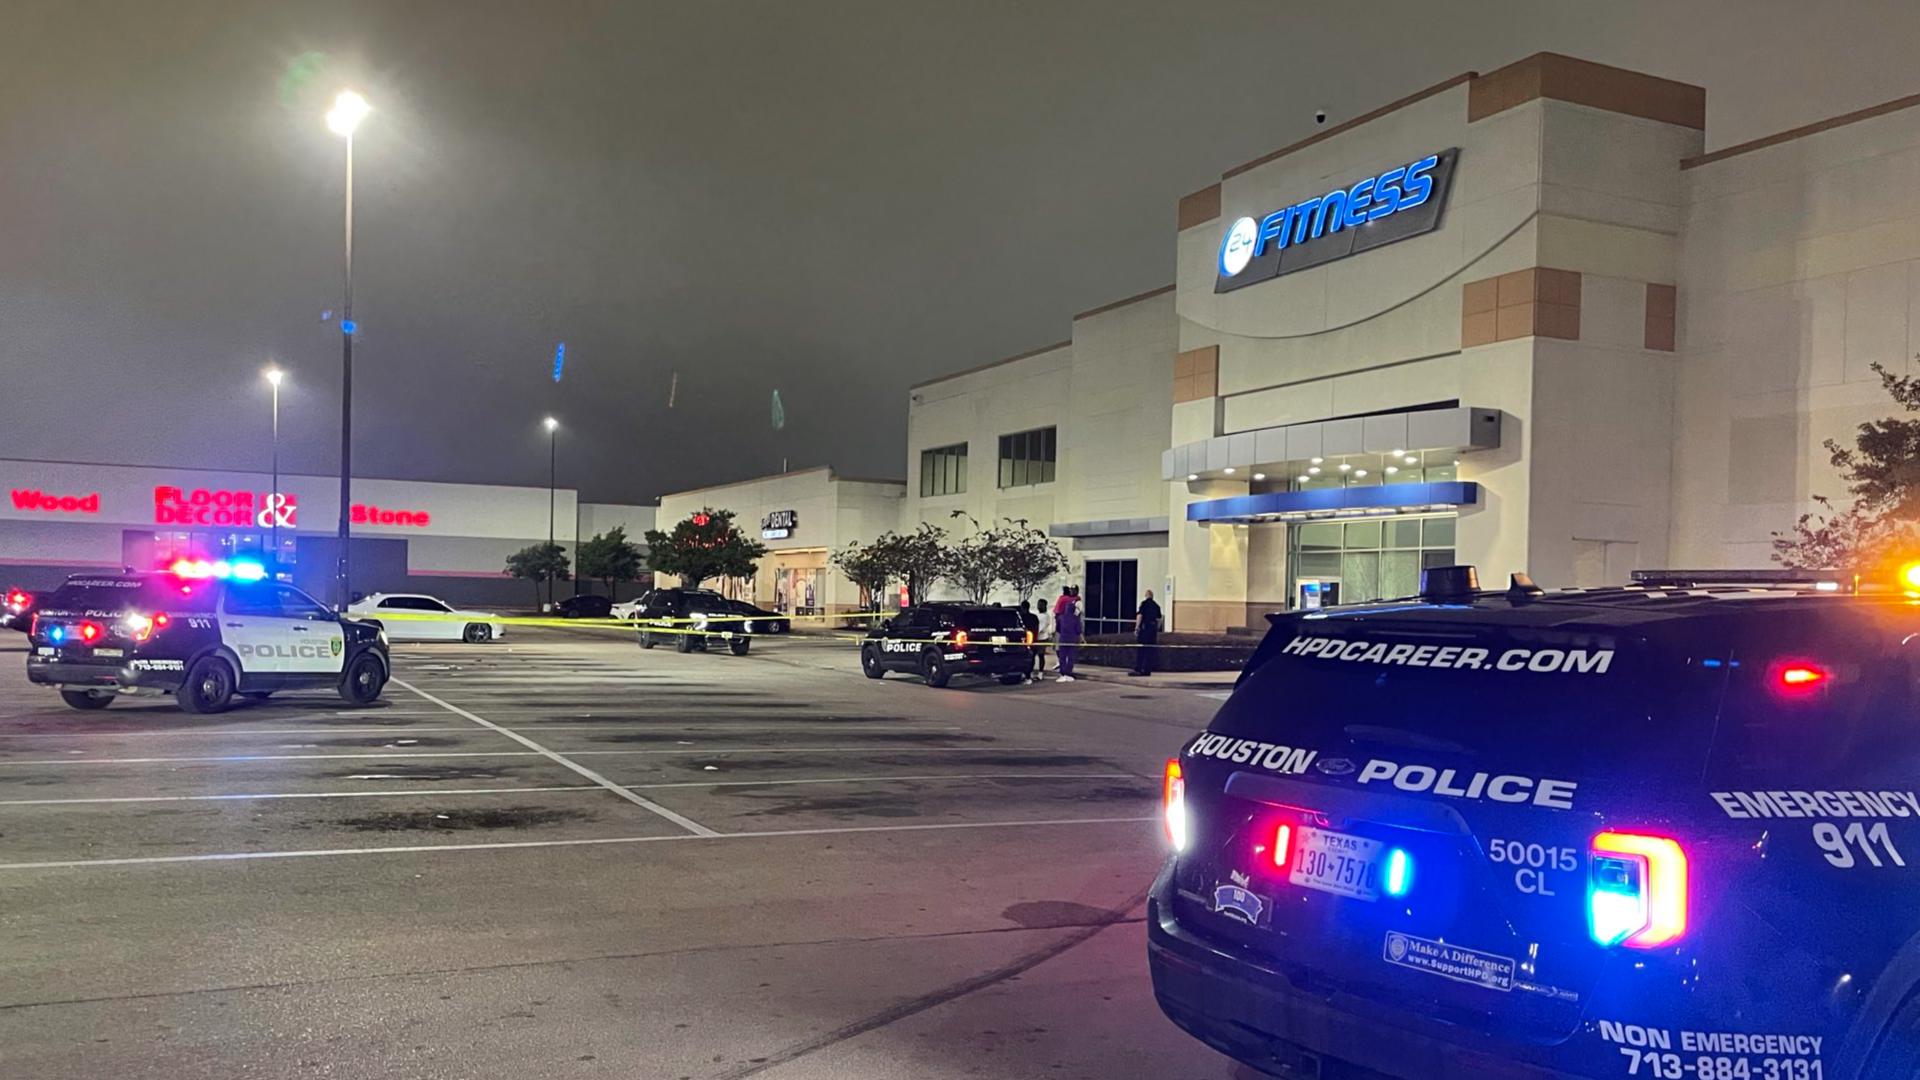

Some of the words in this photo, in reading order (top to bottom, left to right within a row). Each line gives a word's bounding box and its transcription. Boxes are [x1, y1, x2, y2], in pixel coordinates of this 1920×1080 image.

[1254, 154, 1438, 257] FITNESS
[11, 488, 100, 513] Wood
[154, 485, 254, 506] FLOOR
[155, 505, 254, 526] DECOR
[257, 493, 297, 528] &
[351, 503, 430, 528] Stone
[188, 618, 211, 629] 911
[237, 644, 330, 658] POLICE
[886, 642, 922, 653] POLICE
[1282, 637, 1614, 673] HPDCAREER.COM
[1189, 732, 1317, 774] HOUSTON
[1357, 759, 1577, 810] POLICE
[1709, 791, 1920, 818] EMERGENCY
[1323, 835, 1358, 851] TEXAS
[1490, 839, 1578, 872] 50015
[1812, 822, 1906, 868] 911
[1515, 868, 1555, 896] CL
[1408, 955, 1509, 987] www.SupportHPD.org
[1409, 941, 1439, 957] Make
[1440, 950, 1450, 960] A
[1452, 950, 1511, 974] Difference
[1599, 1019, 1671, 1050] NON
[1681, 1031, 1823, 1055] EMERGENCY
[1620, 1047, 1823, 1080] 713-884-3131
